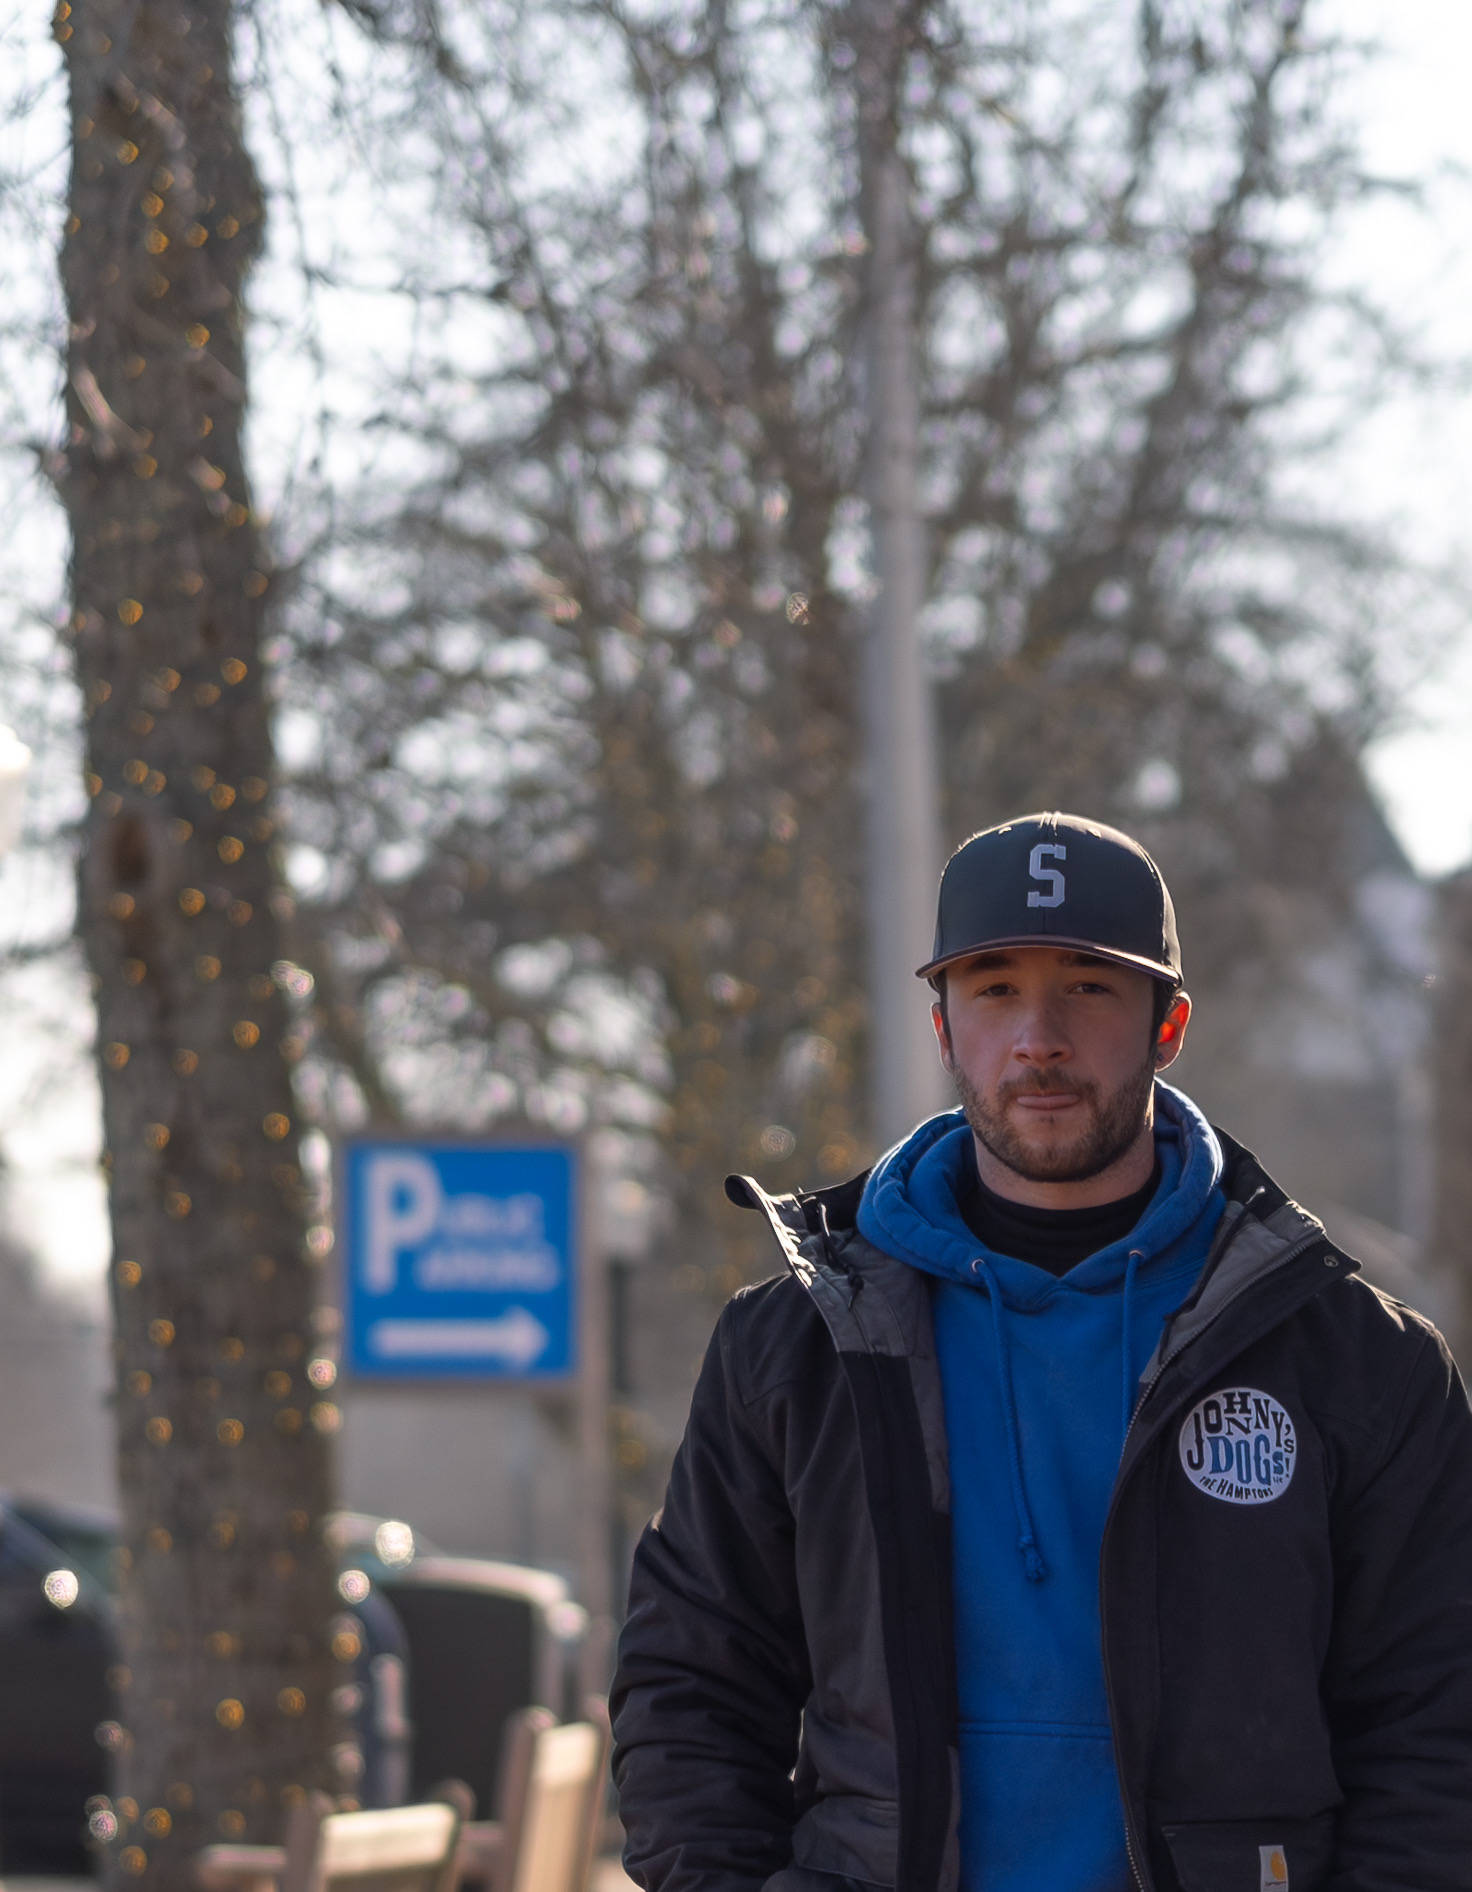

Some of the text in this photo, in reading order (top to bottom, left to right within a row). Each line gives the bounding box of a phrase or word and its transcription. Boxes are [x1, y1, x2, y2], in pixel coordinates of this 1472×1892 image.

[1027, 844, 1066, 907] S
[1186, 1391, 1296, 1472] JOHNNY'S
[1199, 1476, 1218, 1492] THE
[1216, 1478, 1275, 1501] HAMPTONS
